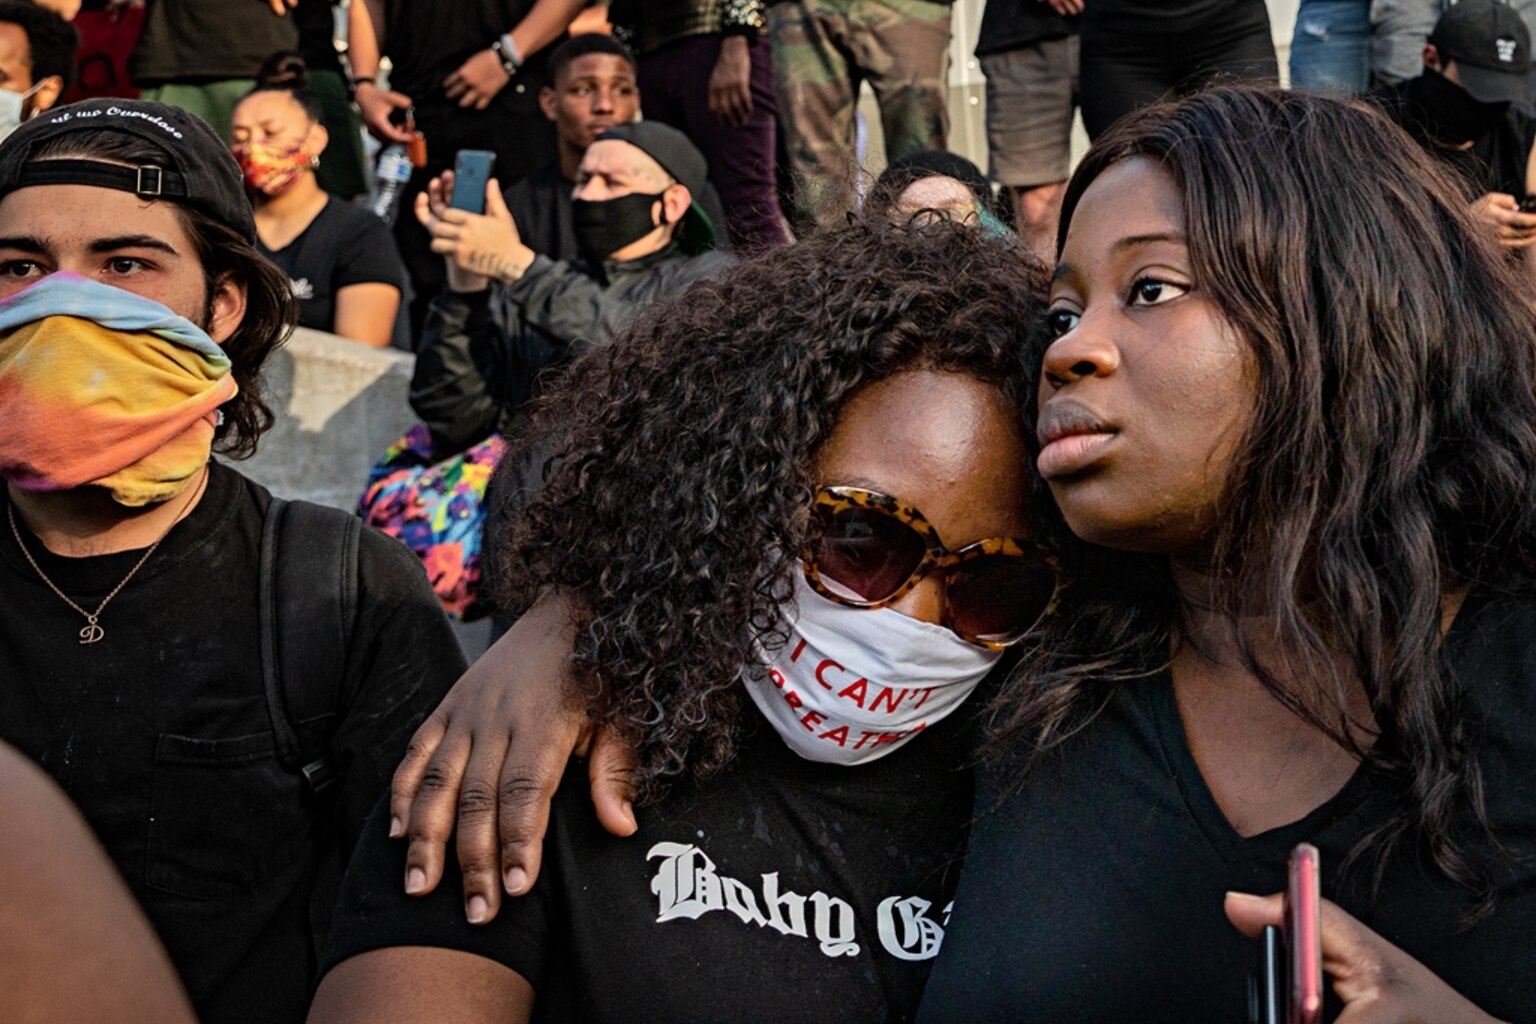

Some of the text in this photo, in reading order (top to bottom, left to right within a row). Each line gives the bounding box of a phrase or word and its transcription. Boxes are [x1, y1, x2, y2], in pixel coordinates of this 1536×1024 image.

[790, 638, 940, 714] I CAN'T
[646, 842, 860, 958] Baby
